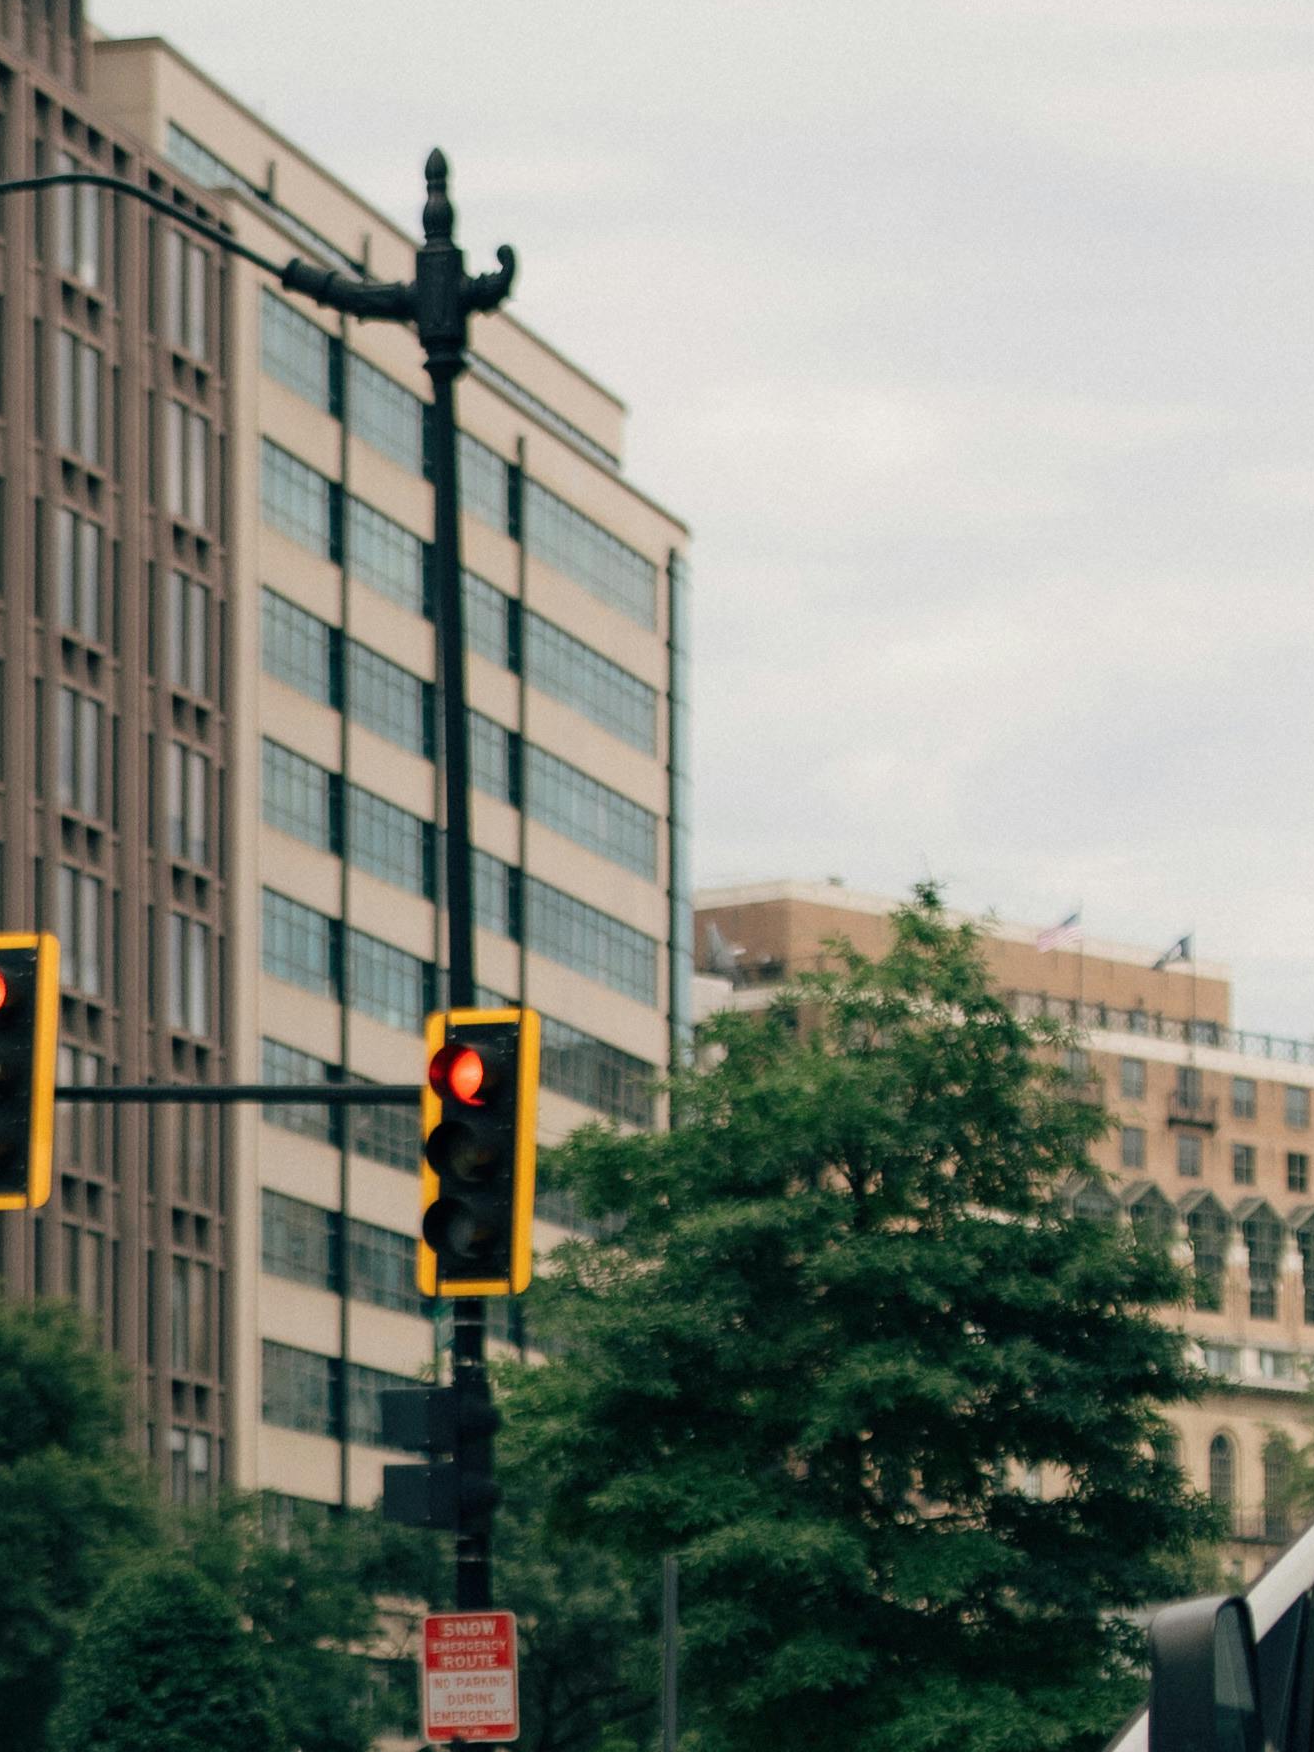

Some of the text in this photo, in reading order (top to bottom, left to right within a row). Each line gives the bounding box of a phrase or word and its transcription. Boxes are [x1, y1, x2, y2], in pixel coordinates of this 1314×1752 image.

[442, 1620, 497, 1637] SNOW
[431, 1639, 508, 1653] EMERGENCY
[442, 1653, 498, 1668] ROUTE
[434, 1676, 509, 1689] NO PARKING
[447, 1693, 496, 1706] DURING
[433, 1709, 511, 1722] EMERGENCY
